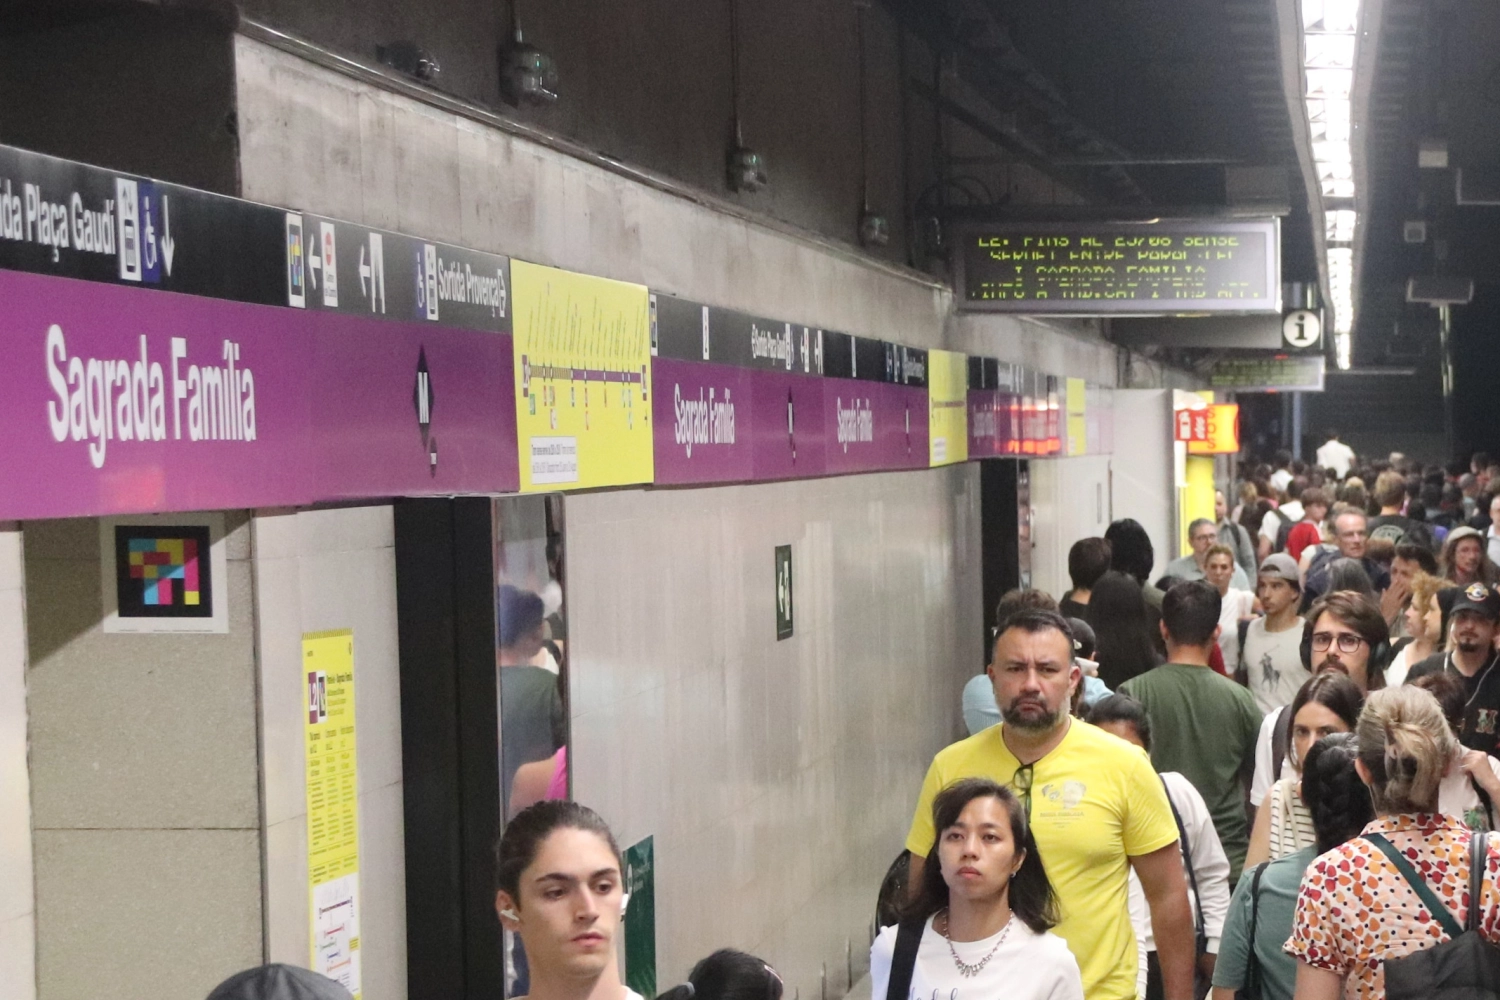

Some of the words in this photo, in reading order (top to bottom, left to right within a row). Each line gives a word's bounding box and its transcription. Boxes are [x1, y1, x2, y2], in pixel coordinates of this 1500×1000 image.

[25, 183, 69, 263] Plaça
[71, 192, 116, 255] Gaudí
[438, 257, 466, 303] Sortida
[466, 263, 499, 318] Provença
[47, 323, 167, 468] Sagrada
[170, 335, 257, 441] Família
[674, 382, 709, 459] Sagrada
[709, 386, 736, 445] Família
